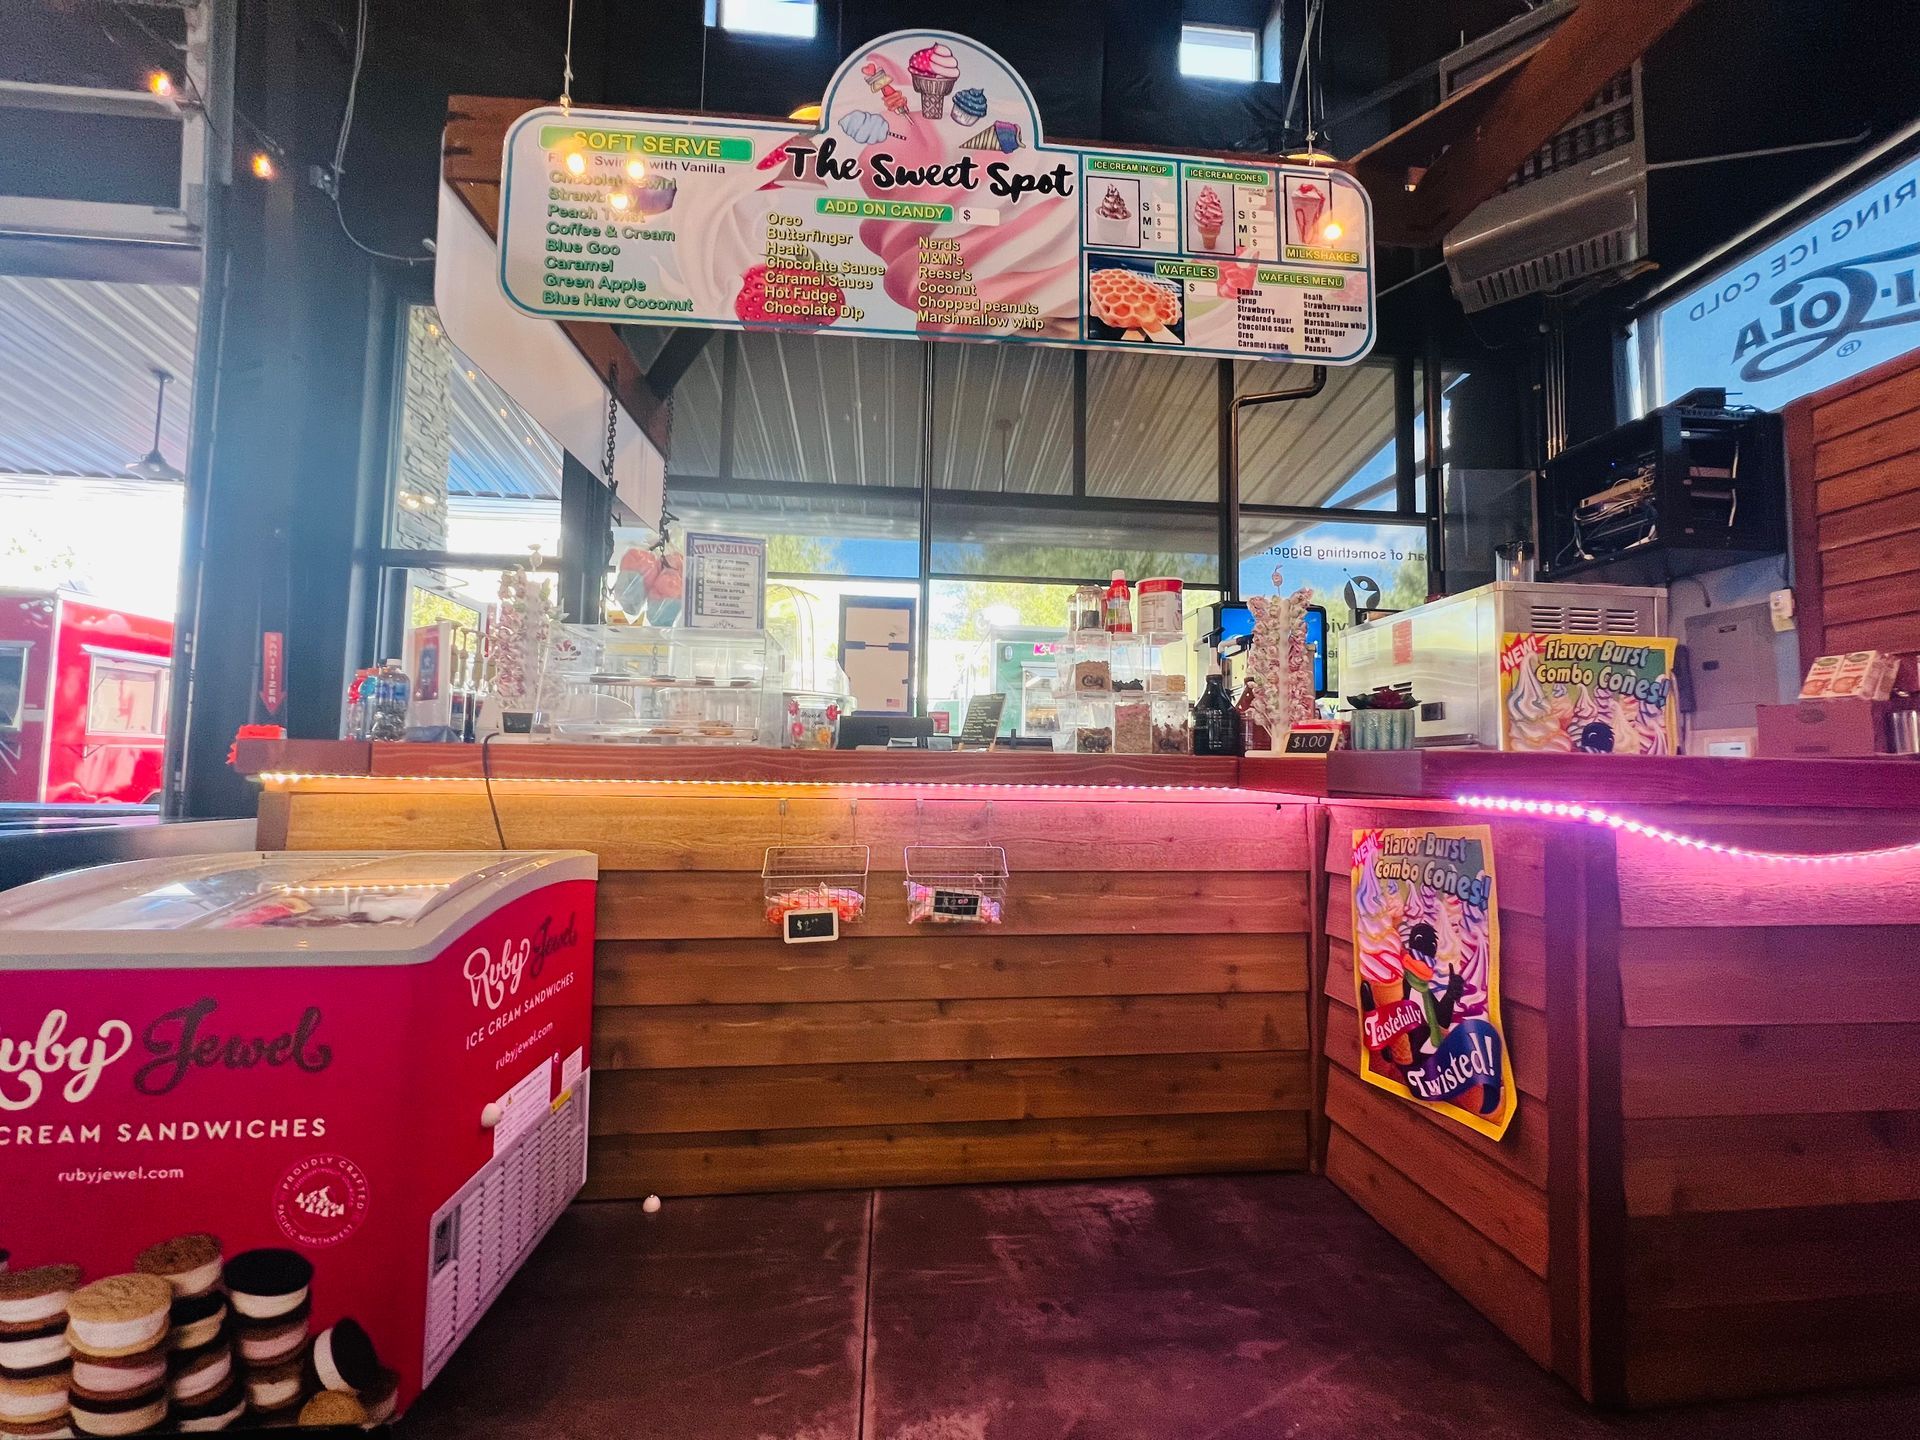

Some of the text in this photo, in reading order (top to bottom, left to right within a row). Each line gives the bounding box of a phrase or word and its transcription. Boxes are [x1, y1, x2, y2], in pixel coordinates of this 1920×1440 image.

[573, 131, 721, 157] SOFT SERVE
[649, 160, 677, 171] with
[682, 162, 725, 174] Vanilla
[785, 137, 1073, 203] The Sweet Spot
[1094, 161, 1167, 174] ICE CREAM IN CUP
[1190, 170, 1263, 183] ICE CREAM CONES
[547, 203, 647, 223] Peach Twist
[824, 200, 971, 221] ADD ON CANDY $
[1142, 202, 1150, 211] S
[1238, 210, 1246, 219] S
[765, 212, 802, 227] Oreo
[1142, 217, 1152, 226] M
[546, 221, 676, 242] Coffee & Cream
[765, 227, 853, 245] Butterfinger
[1142, 231, 1149, 240] L
[1238, 225, 1248, 234] M
[545, 238, 620, 256] Blue Goo
[765, 242, 808, 257] Heath
[918, 236, 960, 251] Nerds
[1239, 239, 1246, 247] L
[544, 256, 613, 272] Caramel
[918, 251, 964, 266] M&M's
[1286, 249, 1358, 263] MILKSHAKES
[764, 256, 885, 276] Chocolate Sauce
[918, 266, 973, 281] Reese's
[1158, 264, 1216, 278] WAFFLES
[543, 274, 646, 292] Green Apple
[764, 271, 873, 290] Caramel Sauce
[917, 281, 976, 296] Coconut
[1188, 282, 1195, 292] $
[1260, 273, 1343, 287] WAFFLES MENU
[542, 290, 580, 305] Blue
[623, 296, 693, 311] Coconut
[764, 286, 837, 304] Hot Fudge
[1237, 296, 1257, 305] Syrup
[763, 300, 864, 321] Chocolate Dip
[917, 295, 1039, 316] Chopped peanuts
[1237, 305, 1275, 315] Strawberry
[1303, 302, 1362, 313] Strawberry sauce
[917, 310, 1044, 331] Marshmallow whip
[1237, 314, 1292, 325] Powdered sugar
[1237, 322, 1294, 333] Chocolate sauce
[1304, 319, 1367, 331] Marshmallow whip
[1238, 331, 1254, 339] Oreo
[1304, 327, 1346, 337] Butterfinger
[1238, 340, 1289, 351] Caramel sauce
[1304, 345, 1332, 353] Peanuts
[1502, 637, 1539, 671] NEW!
[1546, 640, 1649, 667] Flavor Burst
[268, 635, 278, 704] SANITIZER
[1536, 663, 1671, 706] Combo Cones!
[1291, 734, 1327, 750] $1.00
[1351, 833, 1379, 865] NEW!
[1383, 832, 1467, 862] Flavor Burst
[1375, 857, 1492, 910] Combo Cones!
[463, 911, 578, 1010] Ruby Jewel
[465, 972, 574, 1050] ICE CREAM SANDWICHES
[1365, 1004, 1421, 1048] Tastefully
[0, 996, 332, 1111] uby Jewel
[495, 1022, 553, 1070] rubyjewel.com
[1408, 1033, 1495, 1098] Twisted!
[0, 1117, 326, 1146] CREAM SANDWICHES
[57, 1167, 184, 1184] rubyjewel.com
[283, 1157, 333, 1190] PROUDLY
[338, 1160, 366, 1209] CRAFTED
[278, 1204, 353, 1245] PACIFIC NORTHWEST
